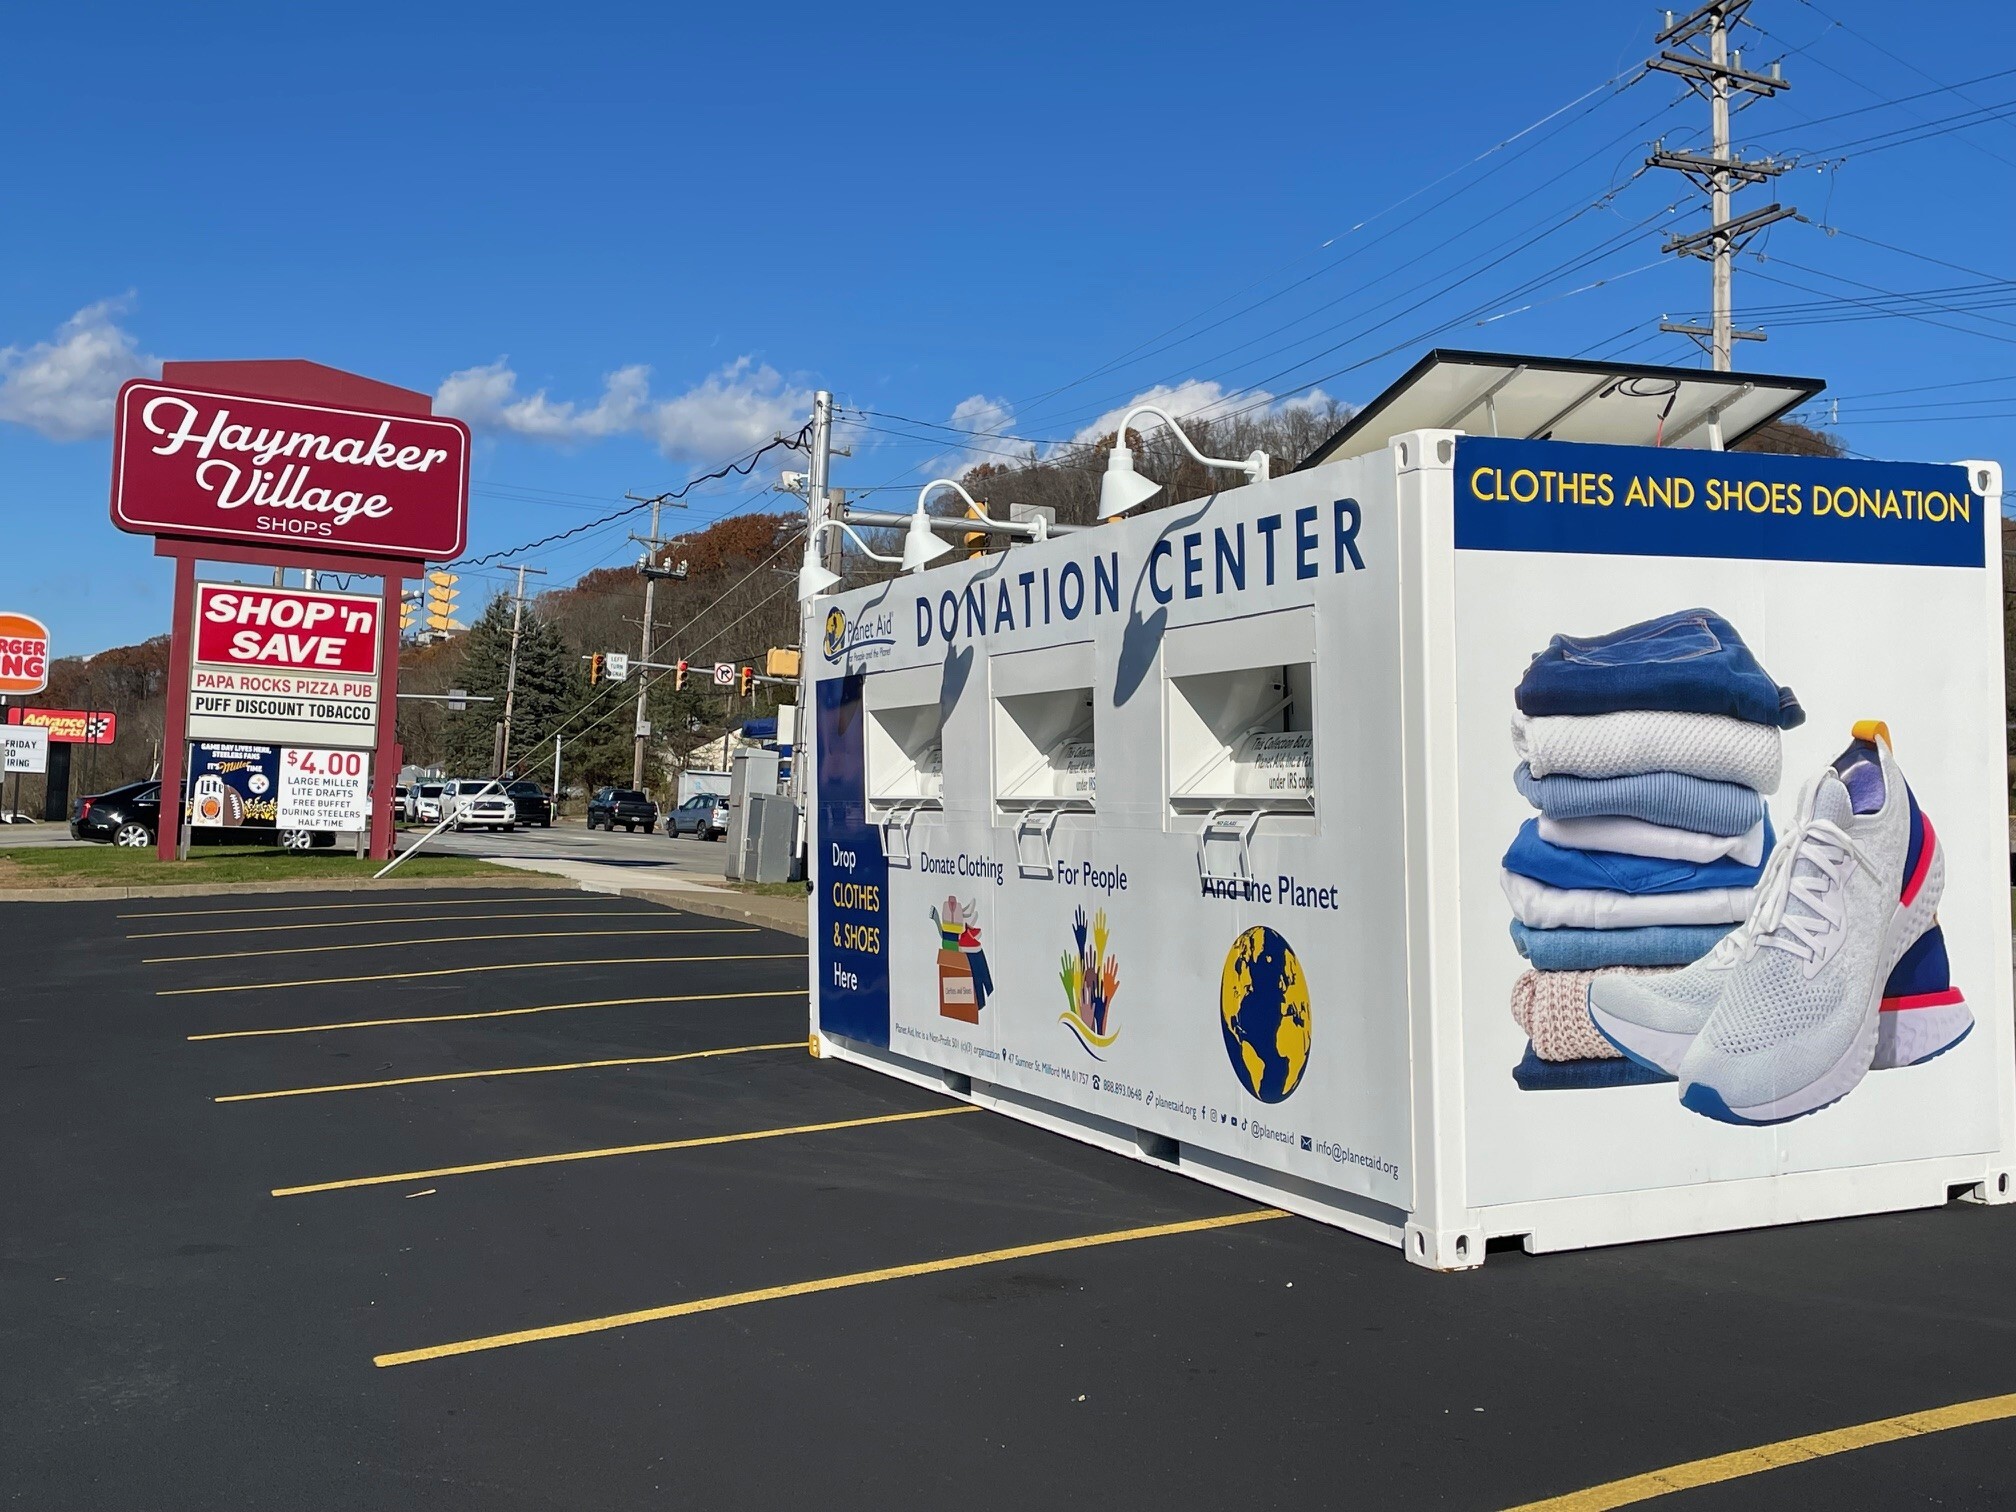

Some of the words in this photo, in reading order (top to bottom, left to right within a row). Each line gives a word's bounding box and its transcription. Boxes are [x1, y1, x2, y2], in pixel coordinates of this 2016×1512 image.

[142, 396, 447, 472] Haymaker
[196, 459, 393, 526] Village
[1471, 467, 1614, 506] CLOTHES
[1625, 476, 1695, 509] AND
[1705, 478, 1802, 515] SHOES
[1812, 485, 1970, 523] DONATION
[256, 517, 332, 536] SHOPS
[916, 552, 1120, 647] DONATION
[1149, 497, 1366, 605] CENTER
[205, 594, 335, 629] SHOP
[847, 620, 873, 643] Planet
[877, 611, 892, 637] Aid
[0, 639, 45, 656] RGER
[228, 630, 347, 666] SAVE
[2, 655, 44, 677] NG
[197, 674, 234, 689] PAPA
[240, 676, 291, 692] ROCKS
[296, 680, 339, 695] PIZZA
[343, 683, 372, 698] PUB
[23, 714, 86, 728] Advance
[195, 697, 231, 712] PUFF
[236, 699, 304, 716] DISCOUNT
[309, 704, 371, 720] TOBACCO
[5, 740, 37, 749] FRIDAY
[212, 751, 243, 759] STEELERS
[7, 758, 30, 767] IRING
[218, 761, 251, 774] Miller
[287, 750, 361, 776] $4.00
[200, 780, 223, 795] Lite
[288, 777, 320, 786] LARGE
[323, 779, 358, 787] MILLER
[292, 788, 313, 796] LITE
[316, 789, 354, 798] DRAFTS
[1268, 773, 1285, 789] under
[1287, 772, 1297, 789] IRS
[1298, 772, 1313, 789] code
[282, 808, 315, 816] DURING
[318, 810, 361, 818] STEELERS
[293, 799, 315, 807] FREE
[318, 800, 351, 808] BUFFET
[298, 819, 320, 827] HALF
[832, 843, 856, 874] Drop
[921, 852, 955, 875] Donate
[958, 854, 1003, 886] Clothing
[1058, 860, 1079, 885] For
[1083, 861, 1127, 897] People
[1202, 870, 1237, 900] And
[1243, 873, 1272, 903] the
[1278, 875, 1338, 909] Planet
[833, 881, 880, 912] CLOTHES
[834, 922, 841, 947] &
[844, 924, 880, 954] SHOES
[834, 962, 858, 990] Here
[1008, 1053, 1014, 1063] 47
[1015, 1055, 1034, 1069] Sumner
[1061, 1068, 1071, 1080] MA
[1072, 1071, 1089, 1085] 01757
[1103, 1079, 1142, 1101] 888.893.0648
[1155, 1095, 1197, 1120] planetaid.org
[1251, 1120, 1295, 1145] @planetaid
[1316, 1140, 1399, 1180] info@planetaid.org
